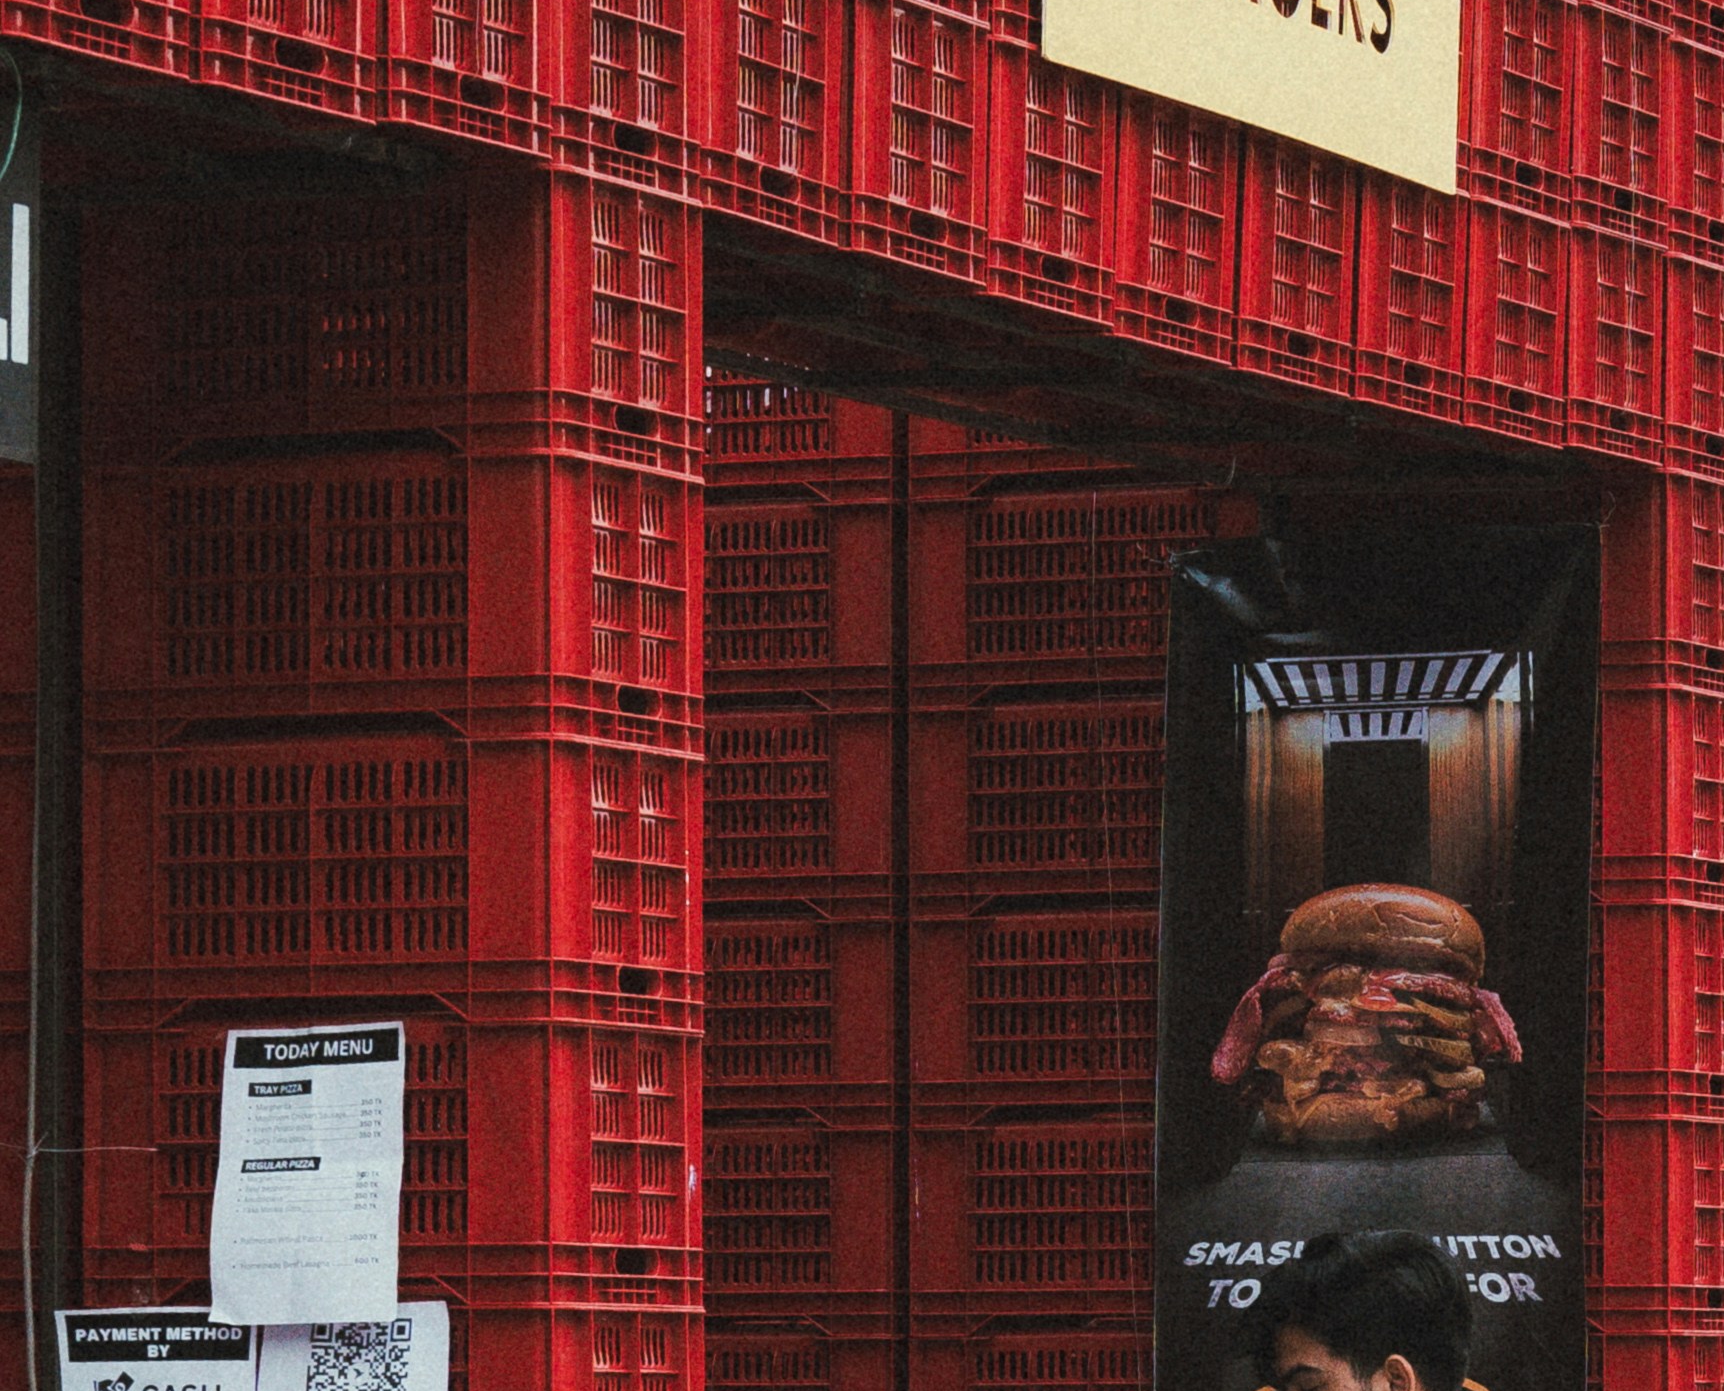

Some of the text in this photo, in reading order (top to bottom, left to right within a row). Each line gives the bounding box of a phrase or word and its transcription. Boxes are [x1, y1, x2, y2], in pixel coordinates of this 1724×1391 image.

[264, 1038, 374, 1061] TODAY MENU
[254, 1083, 303, 1094] TRAY PIZZA
[244, 1159, 316, 1170] REGULAR PIZZA
[1430, 1234, 1562, 1259] UTTON
[1207, 1278, 1262, 1308] TO
[75, 1326, 243, 1342] PAYMENT METHOD
[147, 1344, 170, 1358] BY
